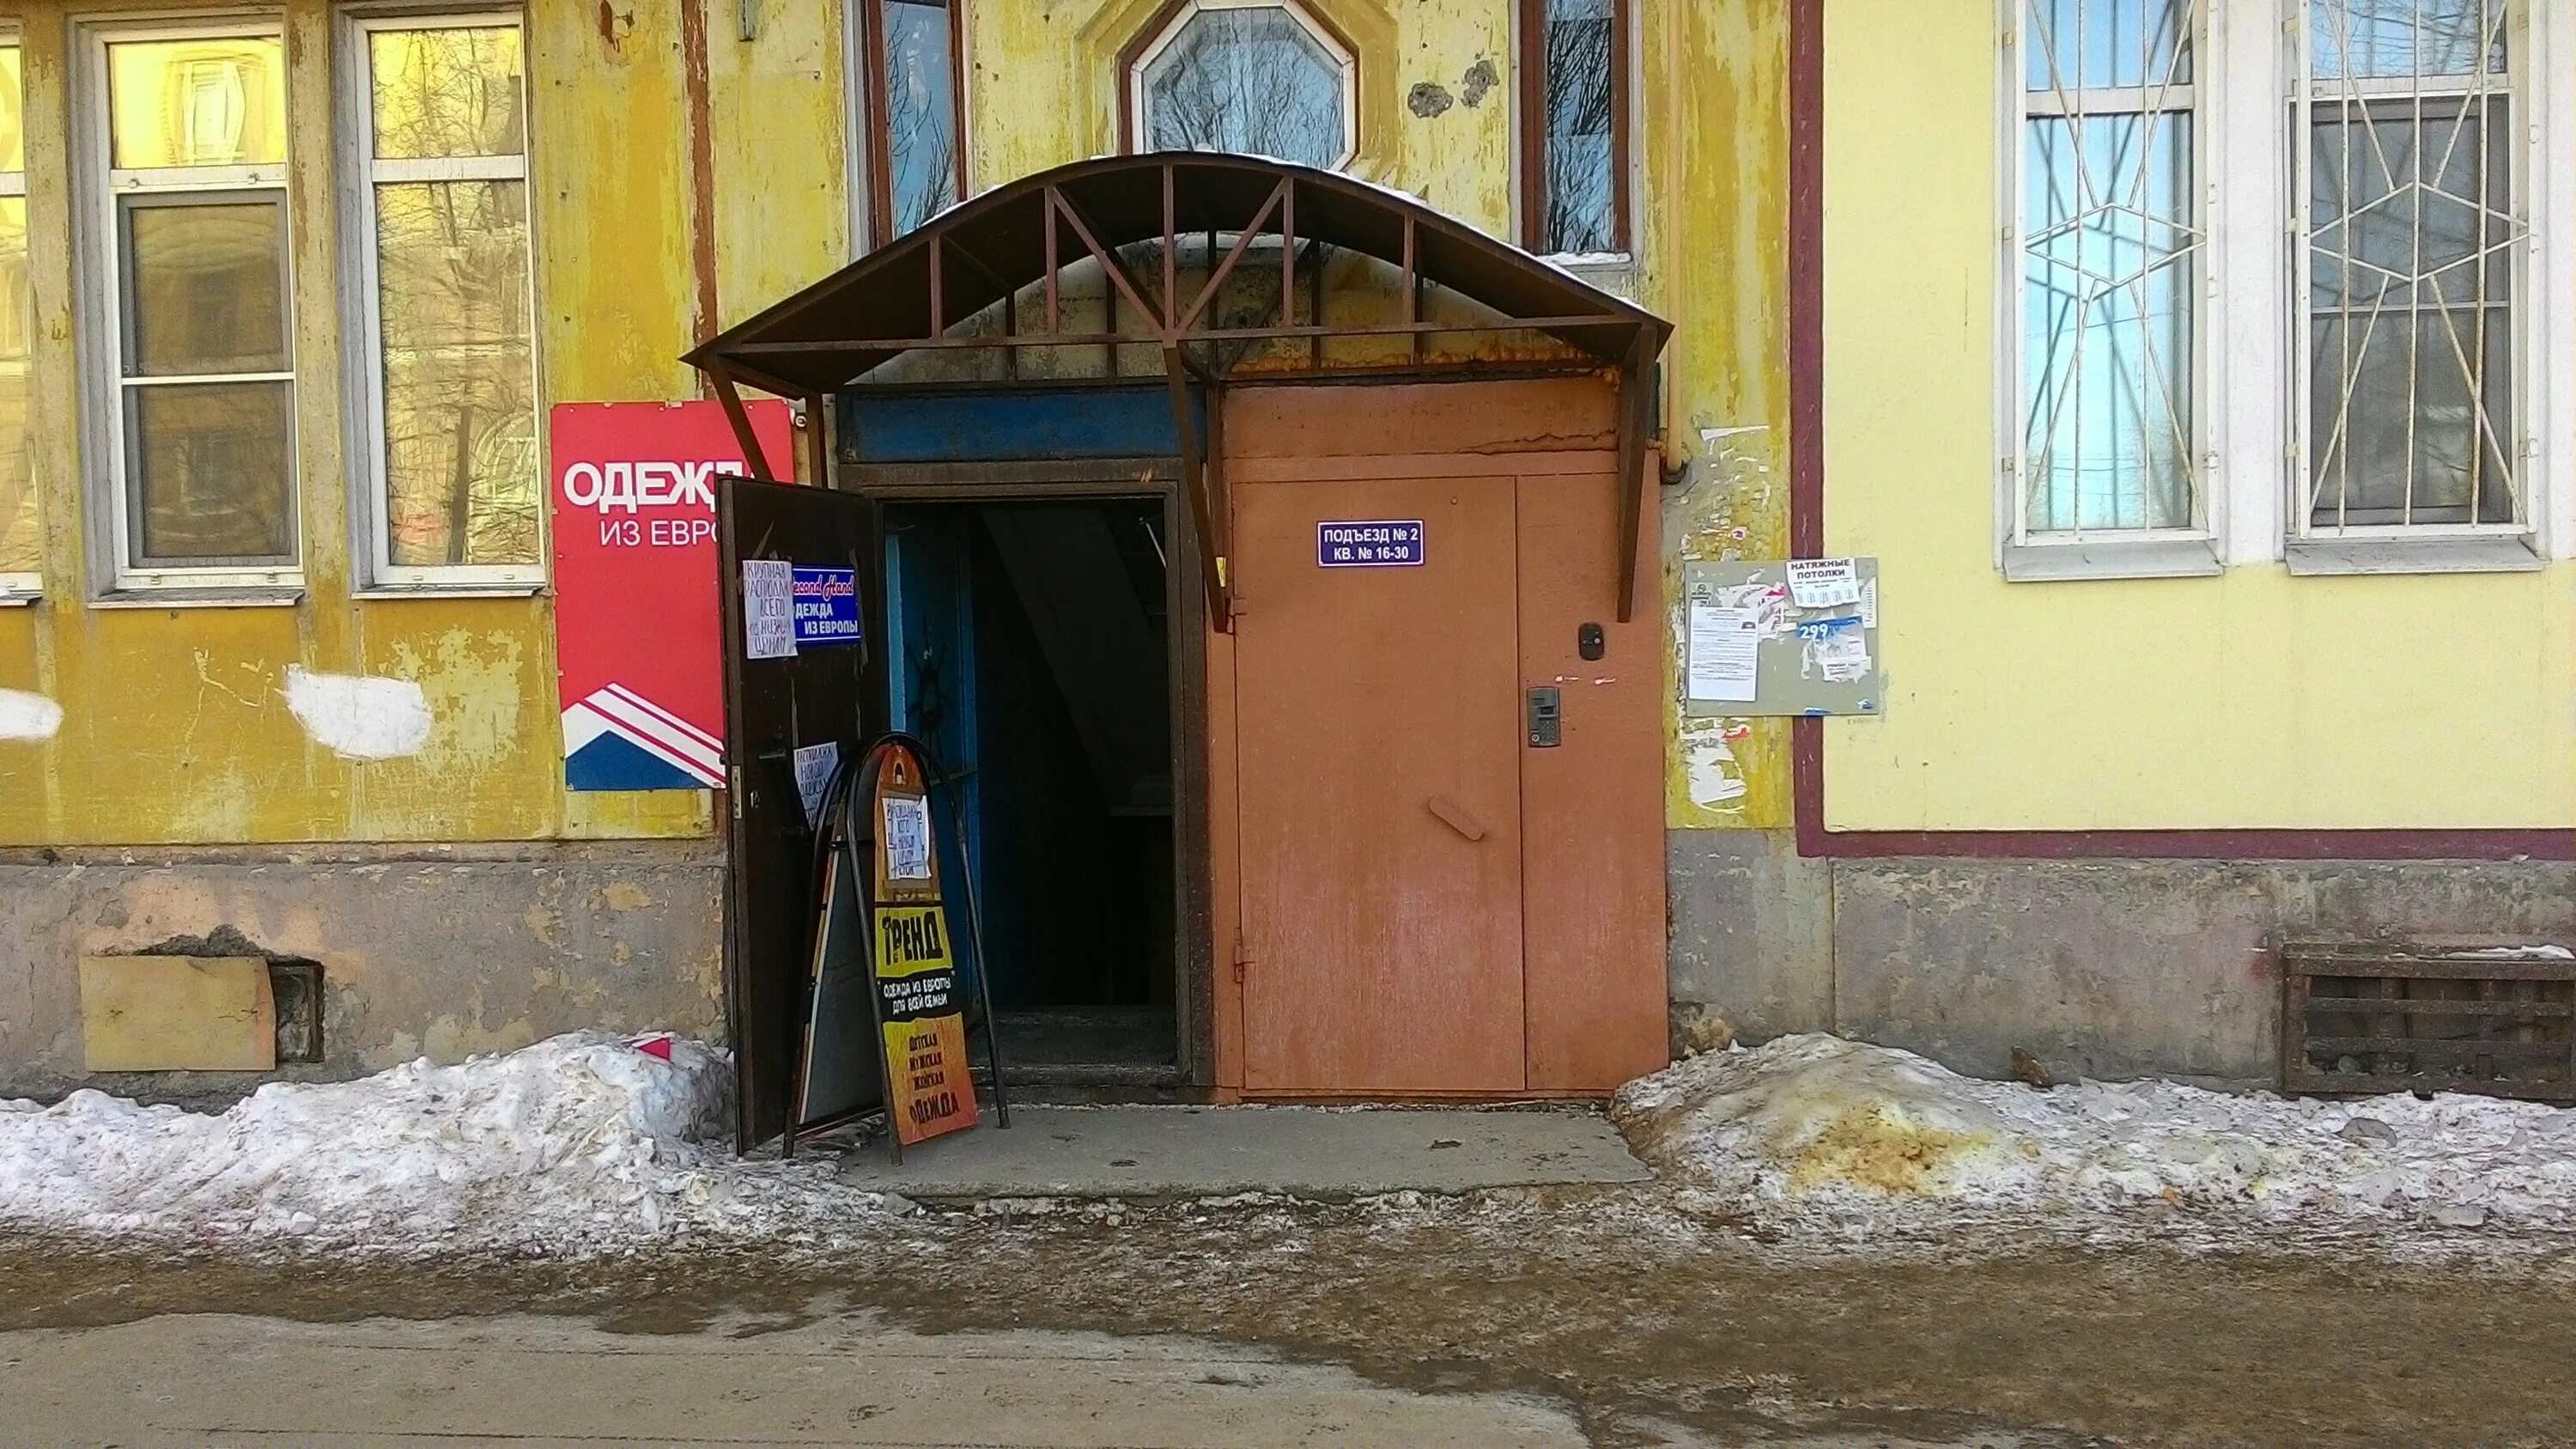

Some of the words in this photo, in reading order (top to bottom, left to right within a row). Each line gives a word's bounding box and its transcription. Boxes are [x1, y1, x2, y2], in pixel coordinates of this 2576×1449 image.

[563, 461, 756, 514] ОДЕЖ
[601, 521, 641, 545] ИЗ
[651, 520, 718, 545] ЕВР
[1324, 528, 1389, 545] ПОДЪЕЗД
[1393, 528, 1407, 541] №
[1411, 527, 1418, 540] 2
[1334, 547, 1355, 560] КВ.
[1358, 546, 1372, 559] №
[1376, 546, 1408, 559] 16-30
[1791, 559, 1850, 570] НАТЯЖНЫЕ
[1797, 569, 1845, 579] ПОТОЛКИ
[793, 575, 823, 595] econd
[823, 575, 854, 602] Hand
[794, 603, 833, 619] ДЕЖДА
[805, 621, 817, 635] ИЗ
[820, 620, 858, 634] ЕВРОПЫ
[1800, 624, 1829, 640] 299
[882, 911, 944, 965] ТРЕНД
[884, 983, 910, 998] ОДЕЖДА
[912, 981, 920, 993] ИЗ
[923, 977, 951, 992] ЕВРОПЫ
[893, 999, 906, 1014] ДЛЯ
[908, 995, 924, 1011] ВСЕЙ
[909, 1092, 960, 1125] ОДЕЖДА
